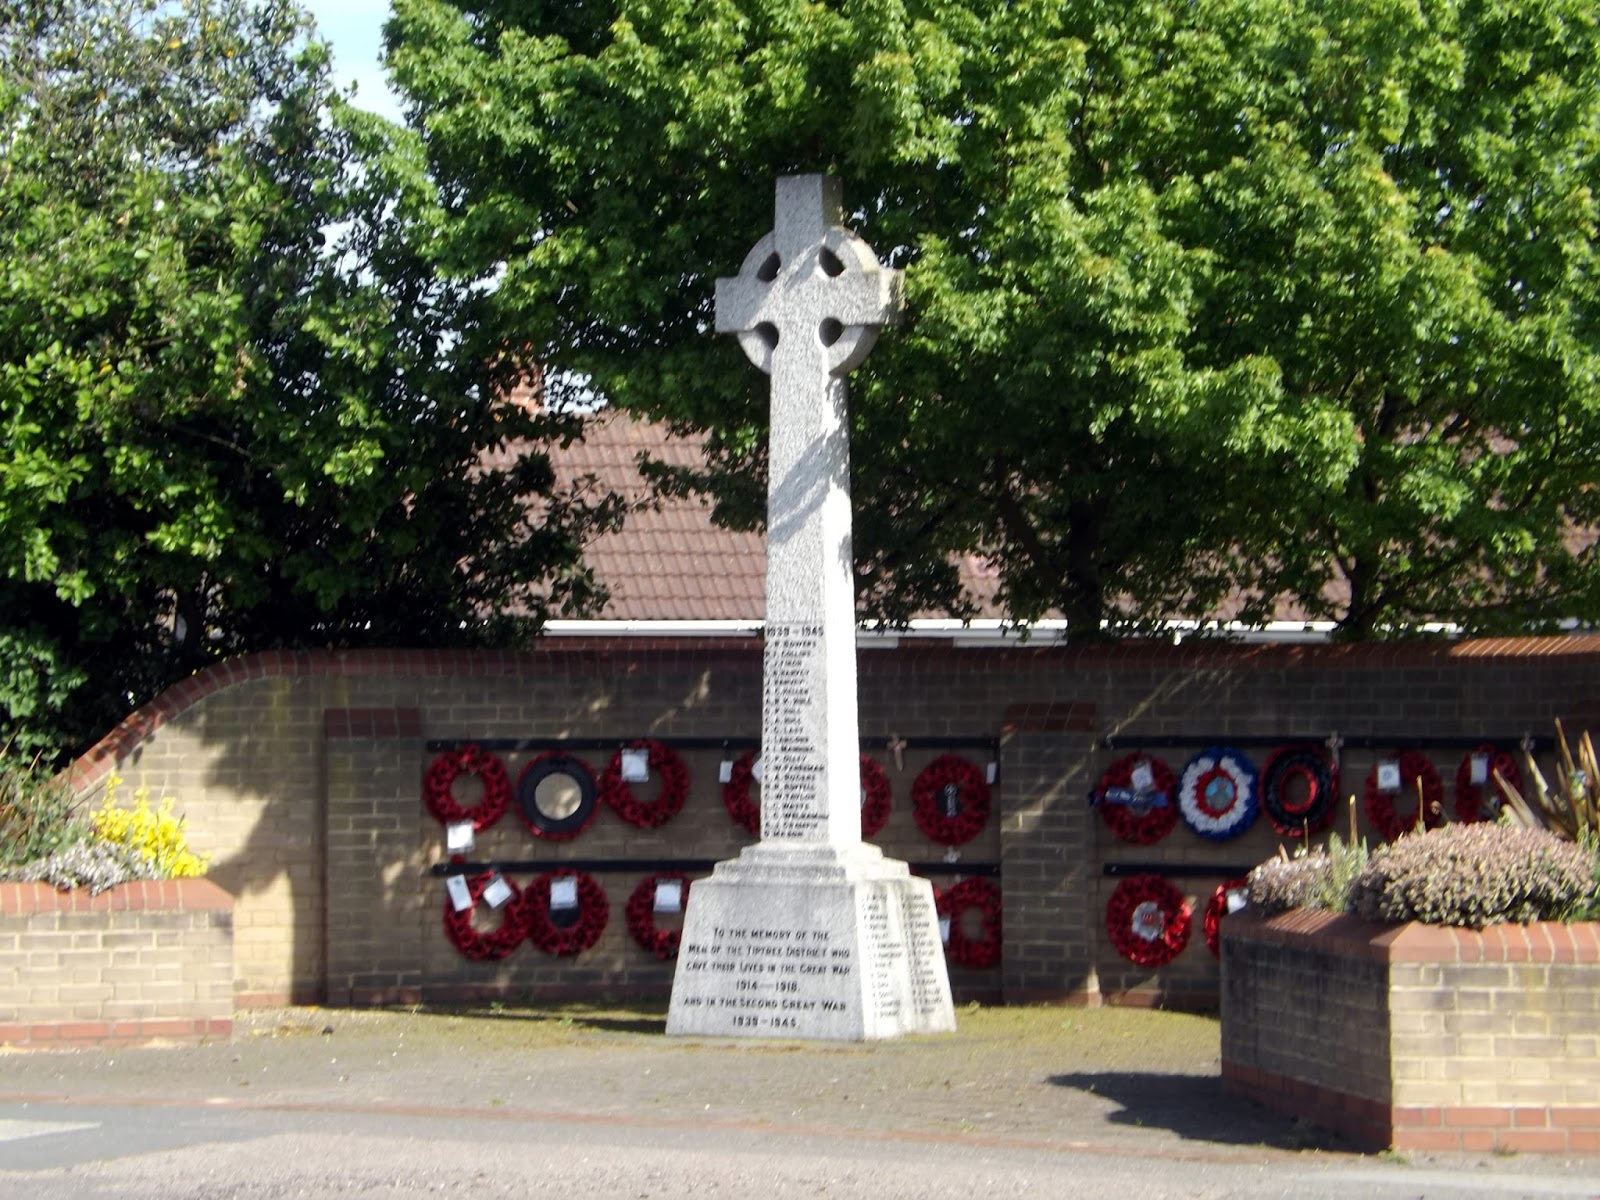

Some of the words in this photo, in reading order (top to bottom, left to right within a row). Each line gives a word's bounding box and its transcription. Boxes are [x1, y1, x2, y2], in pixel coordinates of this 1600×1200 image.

[730, 929, 746, 939] THE
[751, 929, 791, 940] MEMORY
[796, 930, 807, 940] OF
[813, 931, 830, 941] THE
[688, 944, 708, 954] MEN
[711, 945, 722, 955] OF
[727, 946, 742, 955] THE
[747, 946, 782, 956] TIPTREE
[787, 946, 827, 957] DISTRICT
[831, 948, 850, 958] WHO
[712, 962, 735, 972] THEIR
[739, 962, 764, 973] LIVES
[767, 964, 776, 973] IN
[780, 964, 796, 973] THE
[799, 964, 827, 974] GREAT
[684, 996, 702, 1006] AND
[706, 998, 716, 1007] IN
[720, 998, 736, 1007] THE
[740, 997, 778, 1008] SECOND
[781, 999, 815, 1010] GREAT
[822, 1000, 846, 1011] WAR
